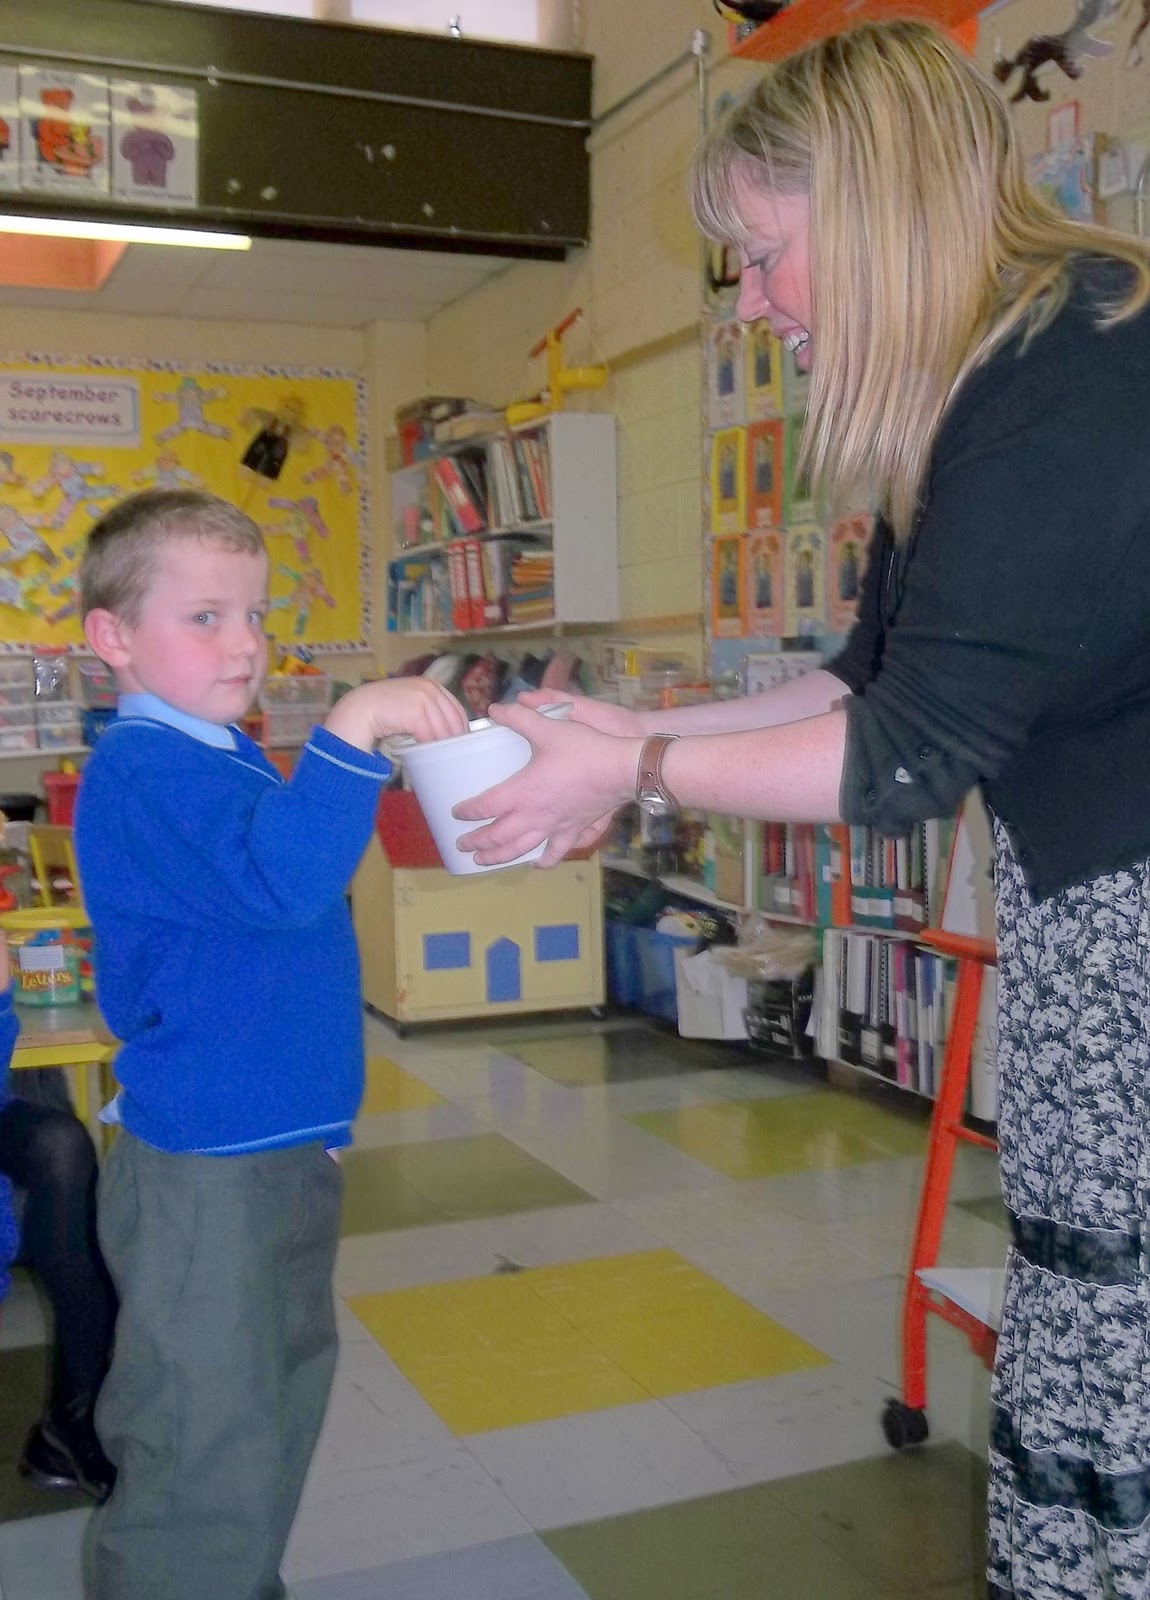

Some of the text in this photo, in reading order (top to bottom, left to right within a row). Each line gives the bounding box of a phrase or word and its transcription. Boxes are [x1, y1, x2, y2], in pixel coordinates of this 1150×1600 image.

[8, 381, 120, 403] September
[8, 408, 121, 425] scarecrows
[22, 972, 71, 989] Letters
